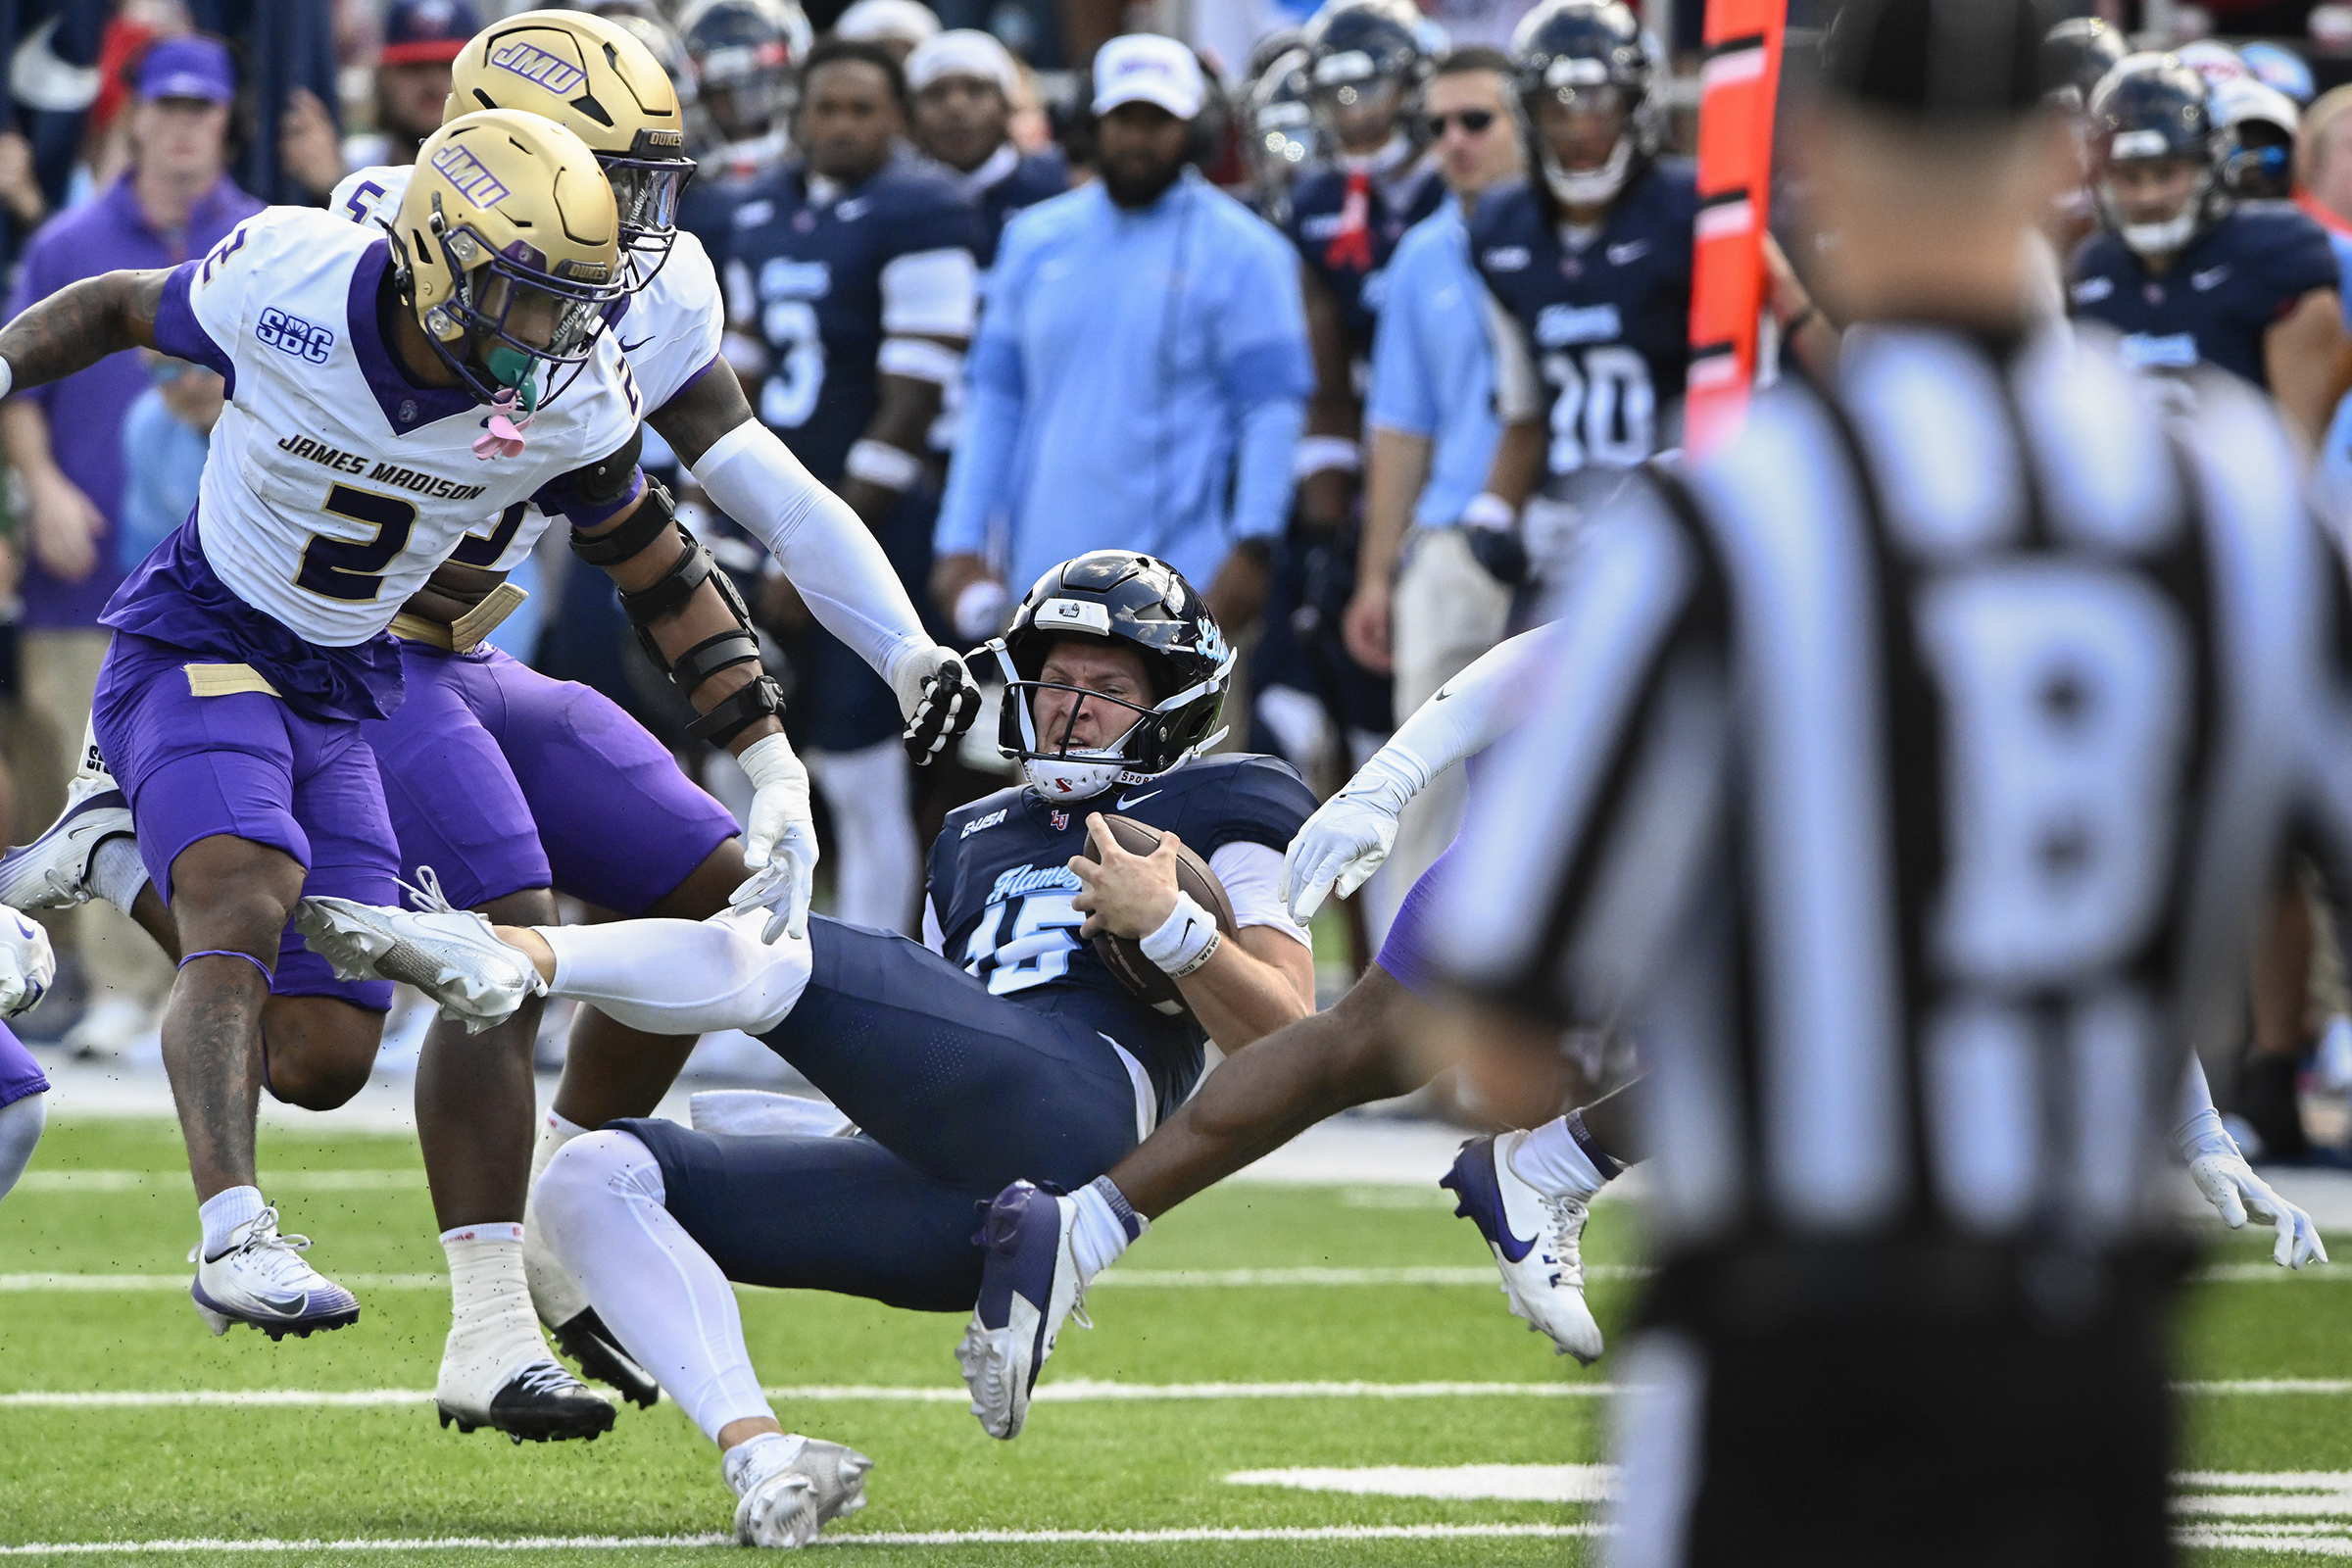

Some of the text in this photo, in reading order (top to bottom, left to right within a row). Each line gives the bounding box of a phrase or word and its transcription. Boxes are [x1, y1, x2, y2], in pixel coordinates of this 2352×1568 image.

[492, 42, 588, 94] JMU
[649, 131, 683, 147] DUKES
[431, 144, 511, 210] JMU
[567, 263, 609, 280] DUKES
[256, 306, 334, 365] SBC
[760, 298, 826, 429] 3
[276, 433, 487, 501] JAMES MADISON
[291, 480, 419, 603] 2
[1050, 809, 1070, 831] LU
[963, 887, 1088, 996] 15
